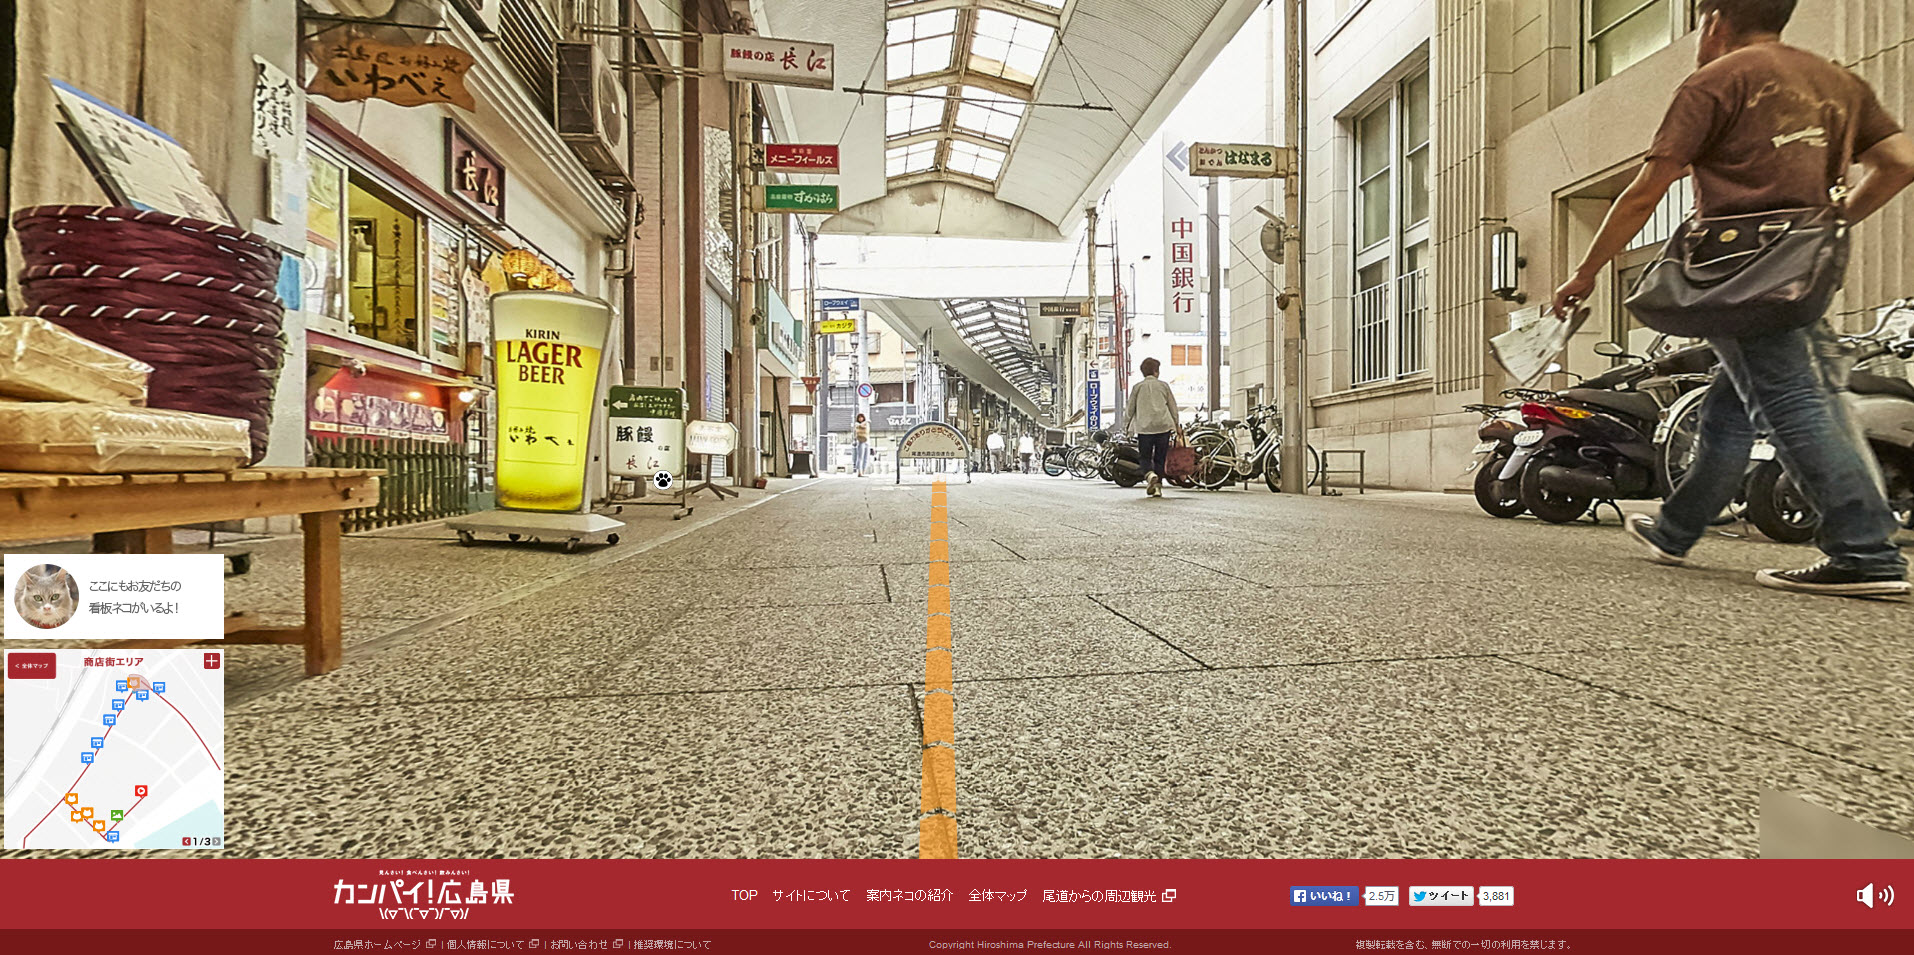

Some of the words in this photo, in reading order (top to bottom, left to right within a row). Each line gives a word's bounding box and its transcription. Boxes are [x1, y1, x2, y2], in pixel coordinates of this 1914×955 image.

[780, 46, 827, 72] 長江
[770, 154, 833, 165] メニーフィールズ
[1224, 150, 1273, 167] はなまる
[1171, 217, 1195, 313] 中国銀行
[525, 328, 560, 340] KIRIN
[506, 340, 583, 369] LAGER
[518, 364, 565, 385] BEER
[616, 425, 654, 443] 豚饅
